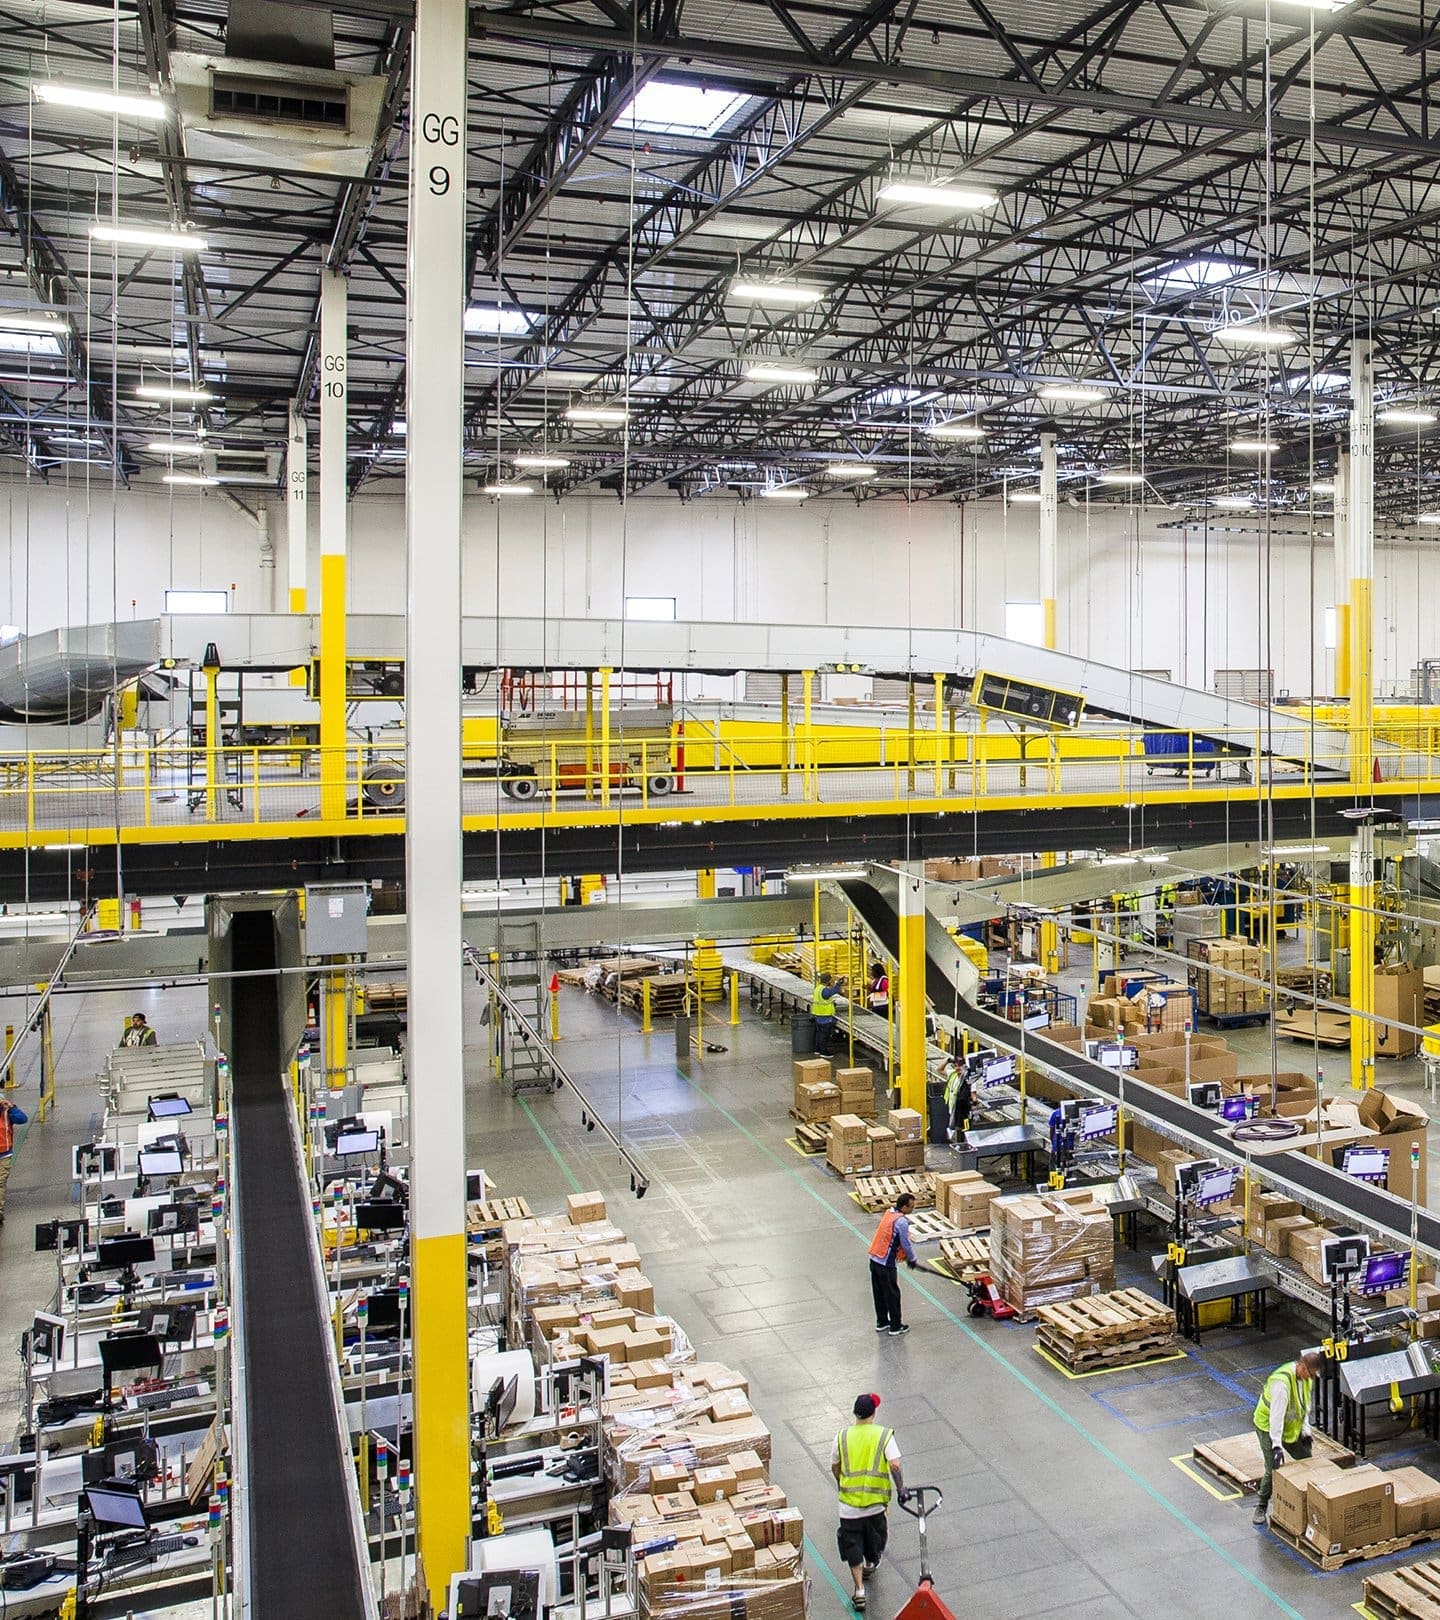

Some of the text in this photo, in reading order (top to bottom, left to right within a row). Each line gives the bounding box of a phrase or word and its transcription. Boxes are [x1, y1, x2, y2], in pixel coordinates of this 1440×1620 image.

[423, 113, 459, 146] GG
[429, 166, 450, 196] 9
[324, 355, 345, 372] GG
[324, 381, 344, 398] 10
[291, 471, 305, 483] GG
[293, 489, 304, 500] 11
